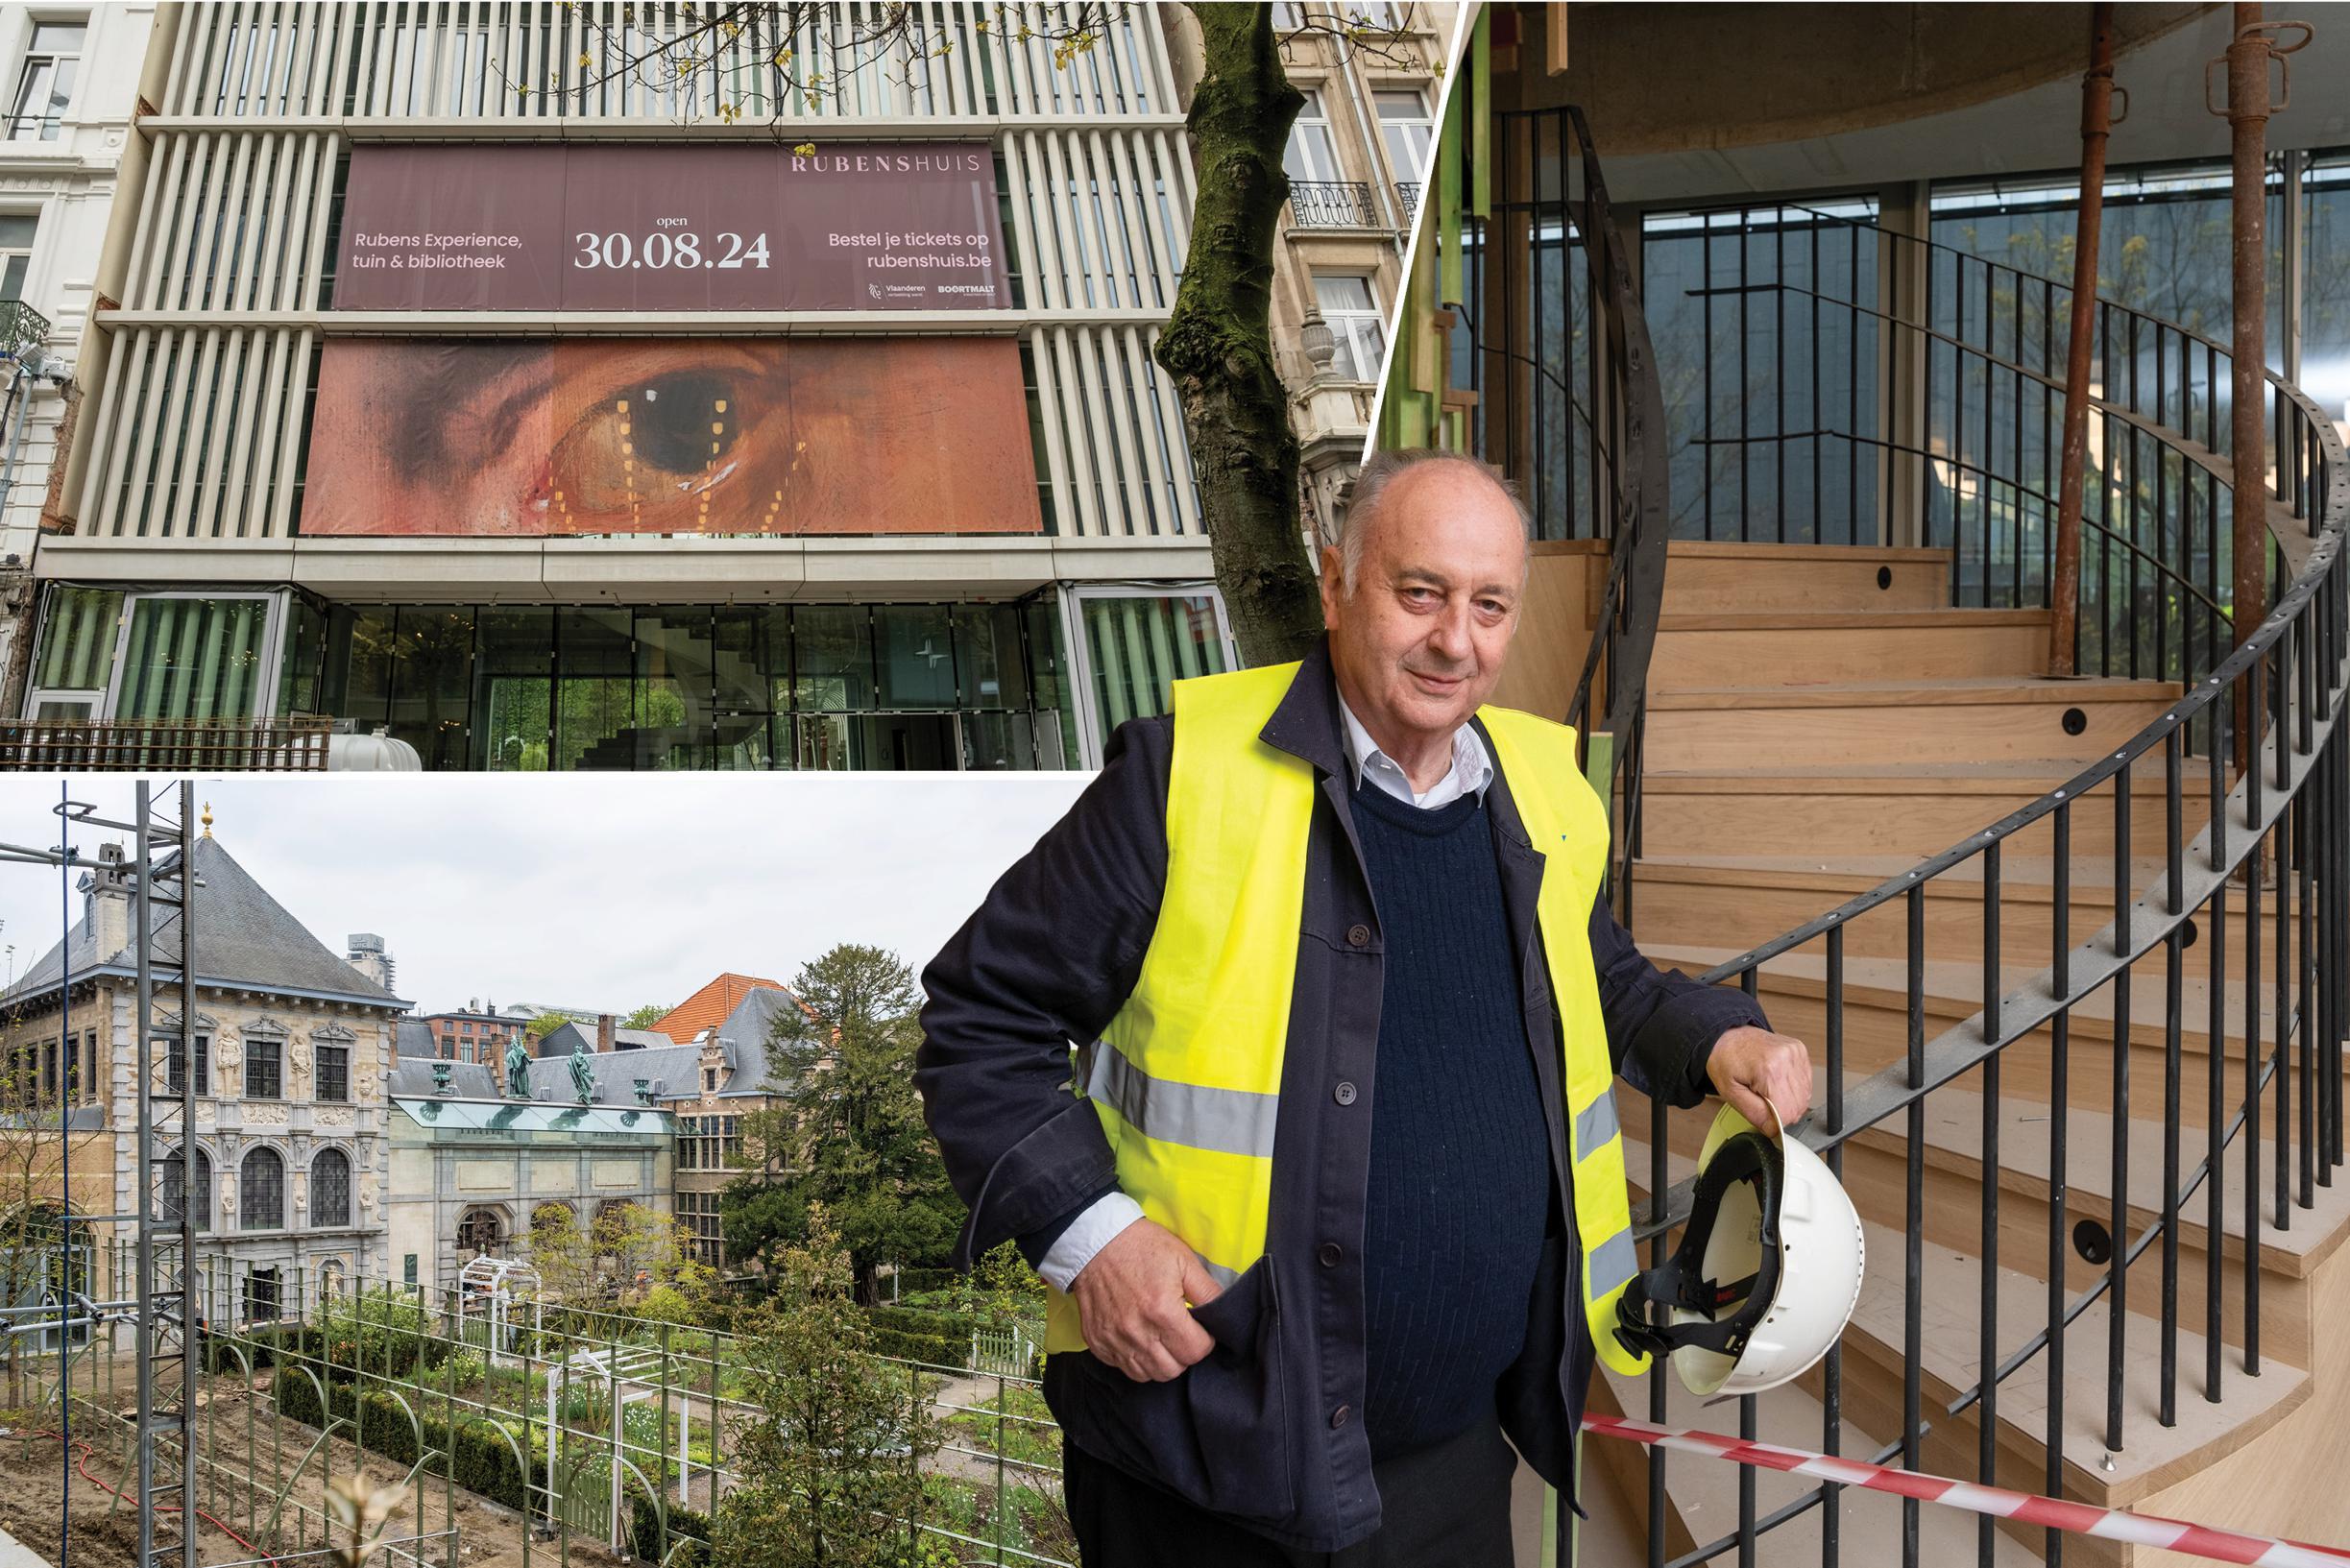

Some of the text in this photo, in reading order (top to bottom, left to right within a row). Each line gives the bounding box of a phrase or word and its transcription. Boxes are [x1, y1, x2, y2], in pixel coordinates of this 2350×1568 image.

[791, 155, 981, 172] RUBENSHUIS
[657, 216, 688, 229] open
[355, 233, 522, 250] Rubens Experience,
[829, 232, 989, 250] Bestel je tickets op
[574, 232, 770, 269] 30.08.24
[352, 254, 506, 268] tuin & bibliotheek
[867, 253, 992, 268] rubenshuis.be
